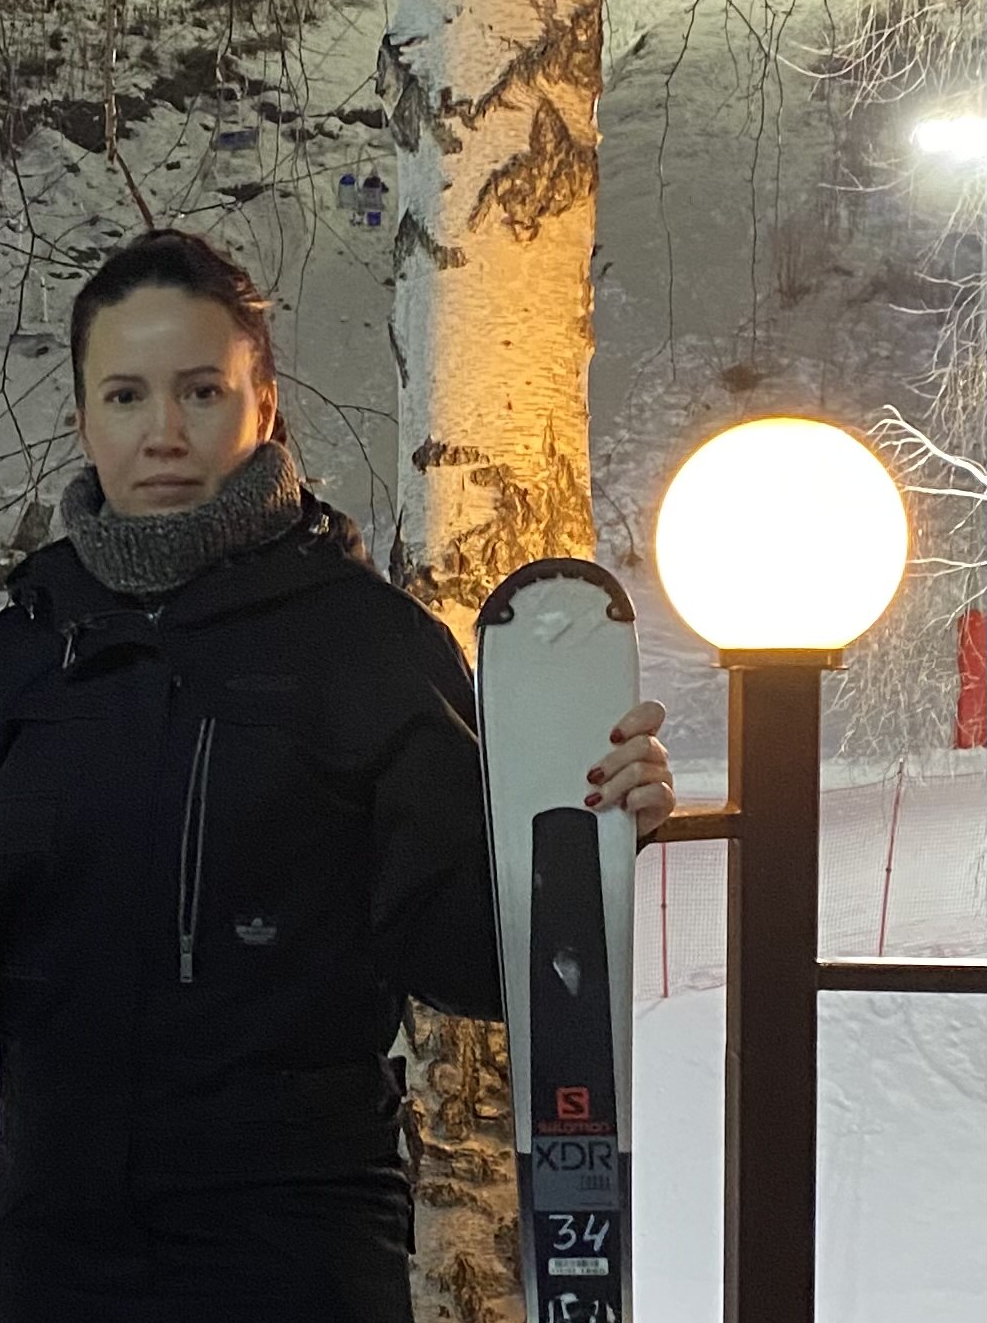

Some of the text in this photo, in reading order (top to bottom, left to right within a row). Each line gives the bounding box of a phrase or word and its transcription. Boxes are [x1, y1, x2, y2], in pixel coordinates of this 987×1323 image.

[560, 1089, 586, 1116] S
[535, 1141, 613, 1171] XDR
[548, 1213, 610, 1252] 34
